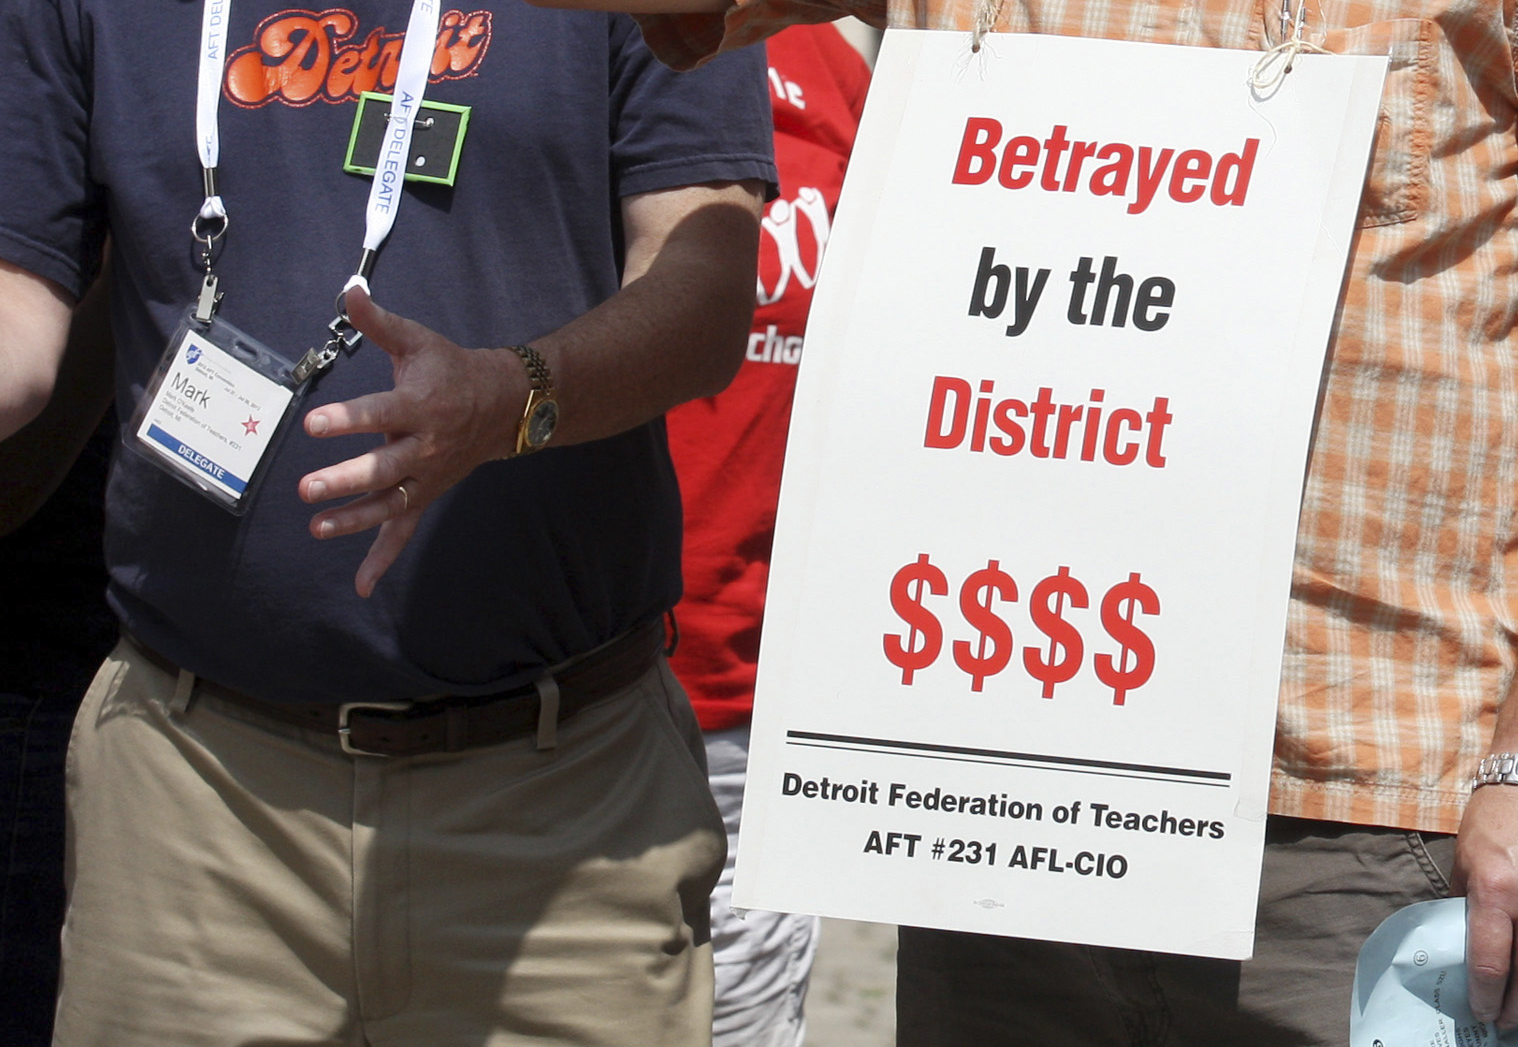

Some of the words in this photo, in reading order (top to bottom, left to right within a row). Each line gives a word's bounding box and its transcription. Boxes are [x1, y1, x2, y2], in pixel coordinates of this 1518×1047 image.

[207, 33, 221, 60] AFT
[223, 8, 493, 110] Detrit
[374, 128, 406, 214] DELEGATE
[951, 116, 1261, 215] Betrayed
[968, 246, 1050, 337] by
[1067, 255, 1176, 332] the
[171, 372, 211, 409] Mark
[923, 375, 1173, 468] District
[178, 444, 226, 480] DELEGATE
[882, 553, 1161, 706] $$$$
[781, 772, 879, 807] Detroit
[888, 783, 1044, 820] Federation
[1051, 798, 1081, 823] of
[1090, 802, 1226, 841] Teachers
[863, 832, 924, 860] AFT
[931, 837, 999, 867] #231
[1008, 845, 1129, 880] AFL-CIO
